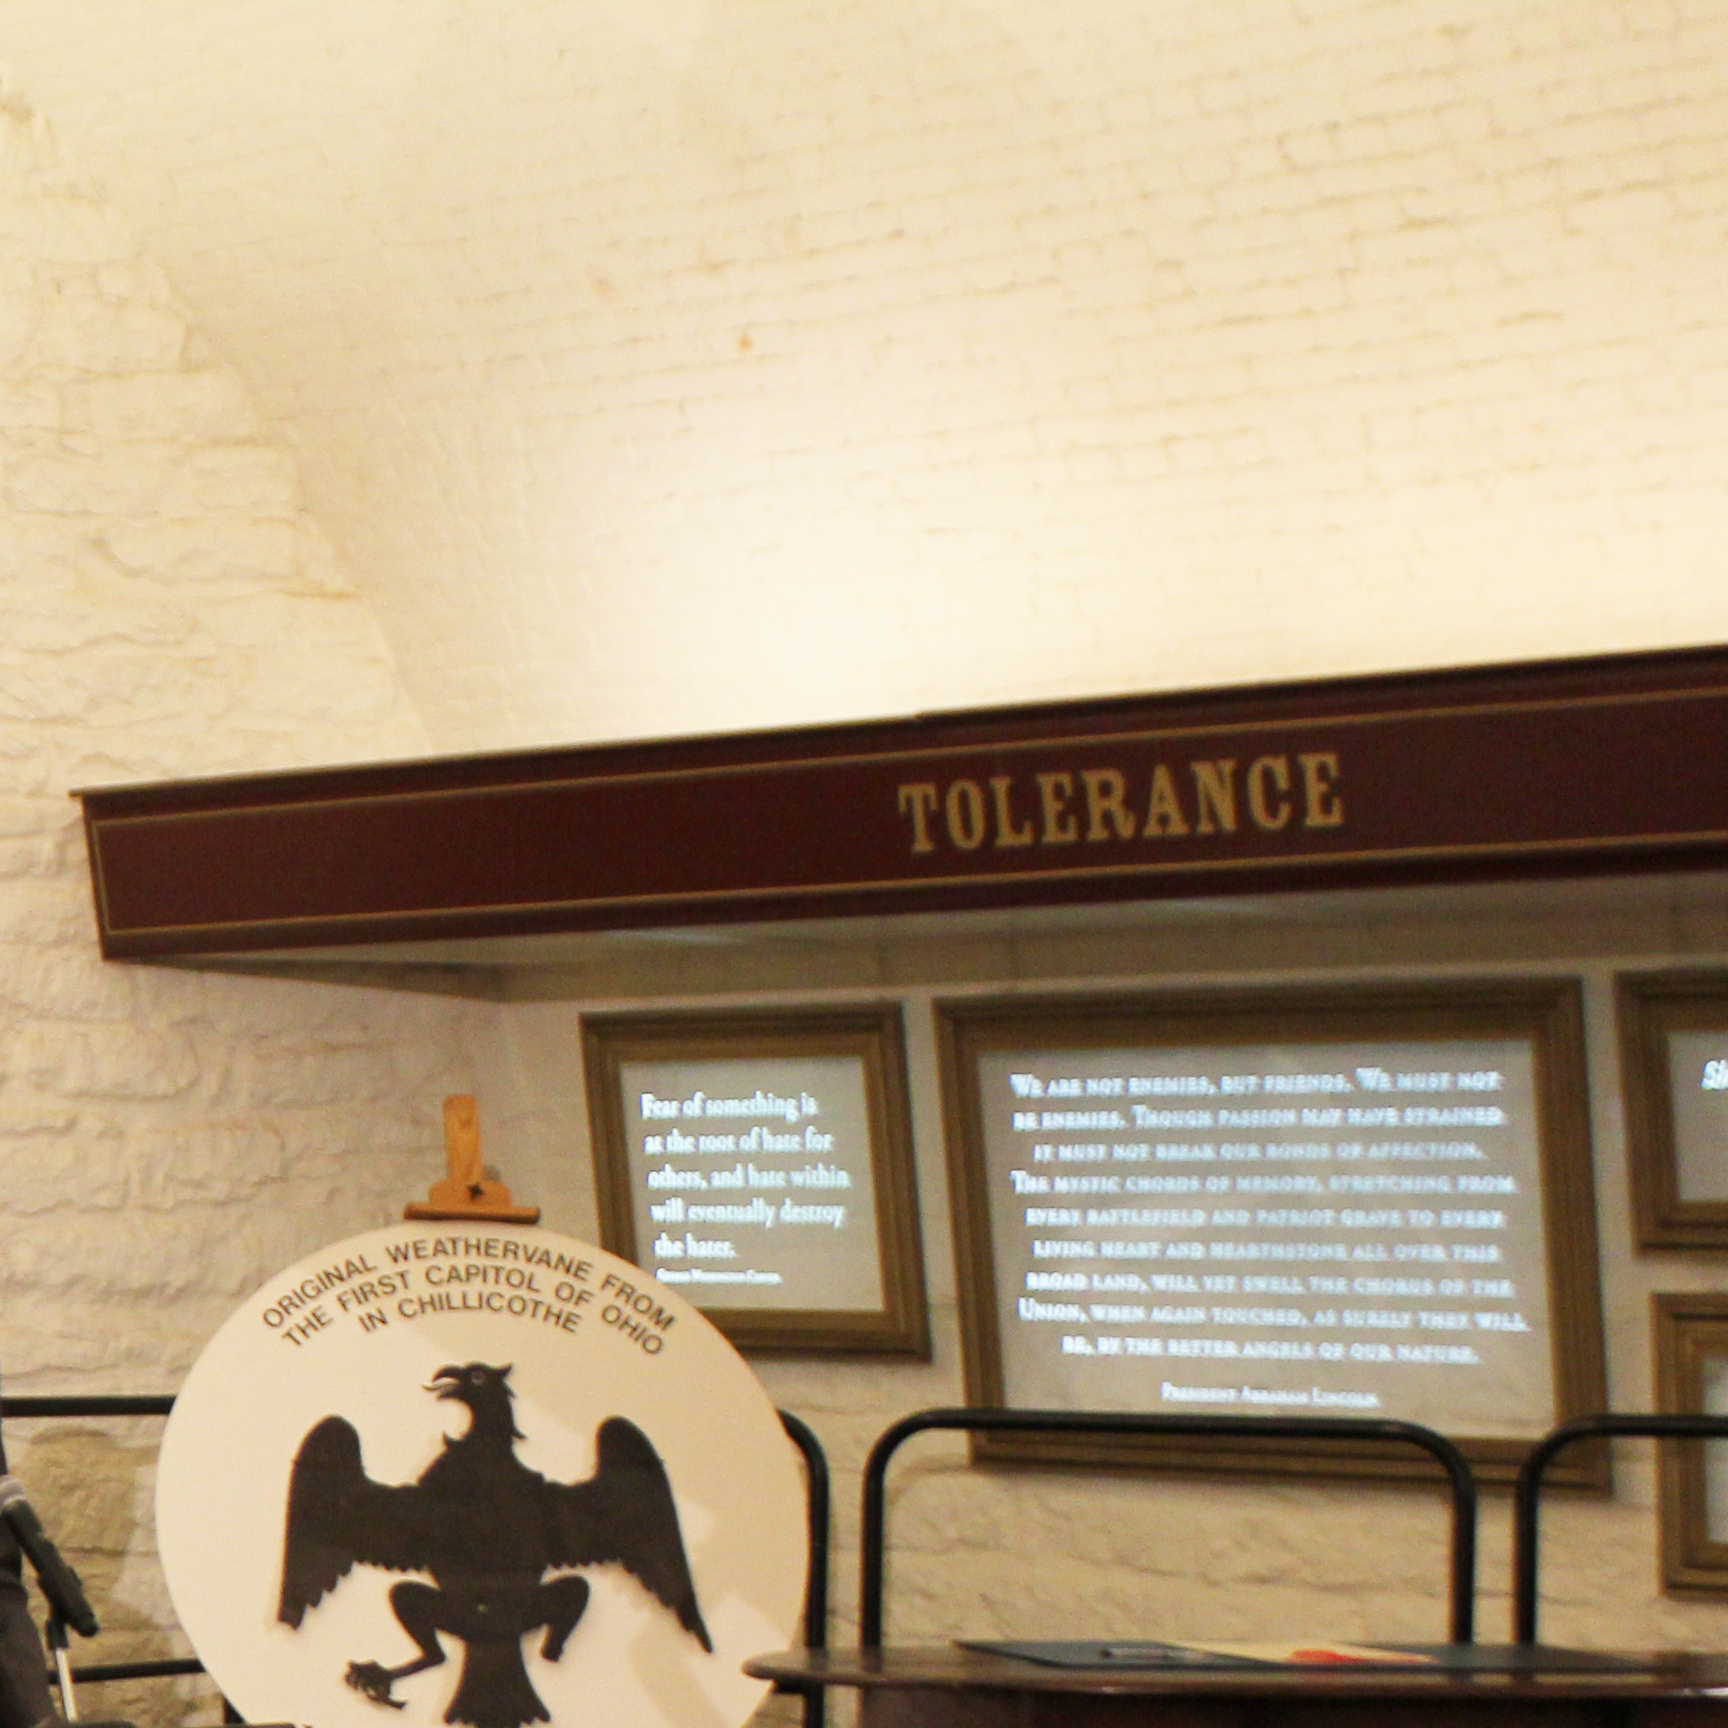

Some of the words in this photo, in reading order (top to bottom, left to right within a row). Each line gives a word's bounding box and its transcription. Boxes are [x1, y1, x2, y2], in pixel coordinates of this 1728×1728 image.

[896, 751, 1343, 854] TOLERANCE
[641, 1093, 680, 1119] Fear
[682, 1091, 705, 1118] of
[705, 1091, 800, 1123] something
[801, 1092, 819, 1117] is
[644, 1136, 664, 1154] at
[666, 1128, 695, 1154] the
[699, 1135, 736, 1153] root
[738, 1126, 760, 1152] of
[762, 1126, 802, 1152] hate
[805, 1125, 834, 1151] for
[647, 1164, 707, 1190] others,
[710, 1163, 744, 1188] and
[747, 1163, 787, 1188] hate
[790, 1163, 851, 1187] within
[650, 1197, 685, 1223] will
[687, 1198, 775, 1229] eventually
[779, 1198, 844, 1229] destroy
[654, 1232, 685, 1258] the
[686, 1232, 738, 1258] hater.
[262, 1254, 378, 1328] ORIGINAL
[385, 1236, 593, 1280] WEATHERVANE
[600, 1273, 675, 1332] FROM
[282, 1305, 332, 1348] THE
[337, 1270, 411, 1311] FIRST
[425, 1265, 540, 1291] CAPITOL
[555, 1279, 593, 1307] OF
[600, 1304, 664, 1356] OHIO
[358, 1310, 390, 1333] IN
[398, 1291, 582, 1333] CHILLICOTHE
